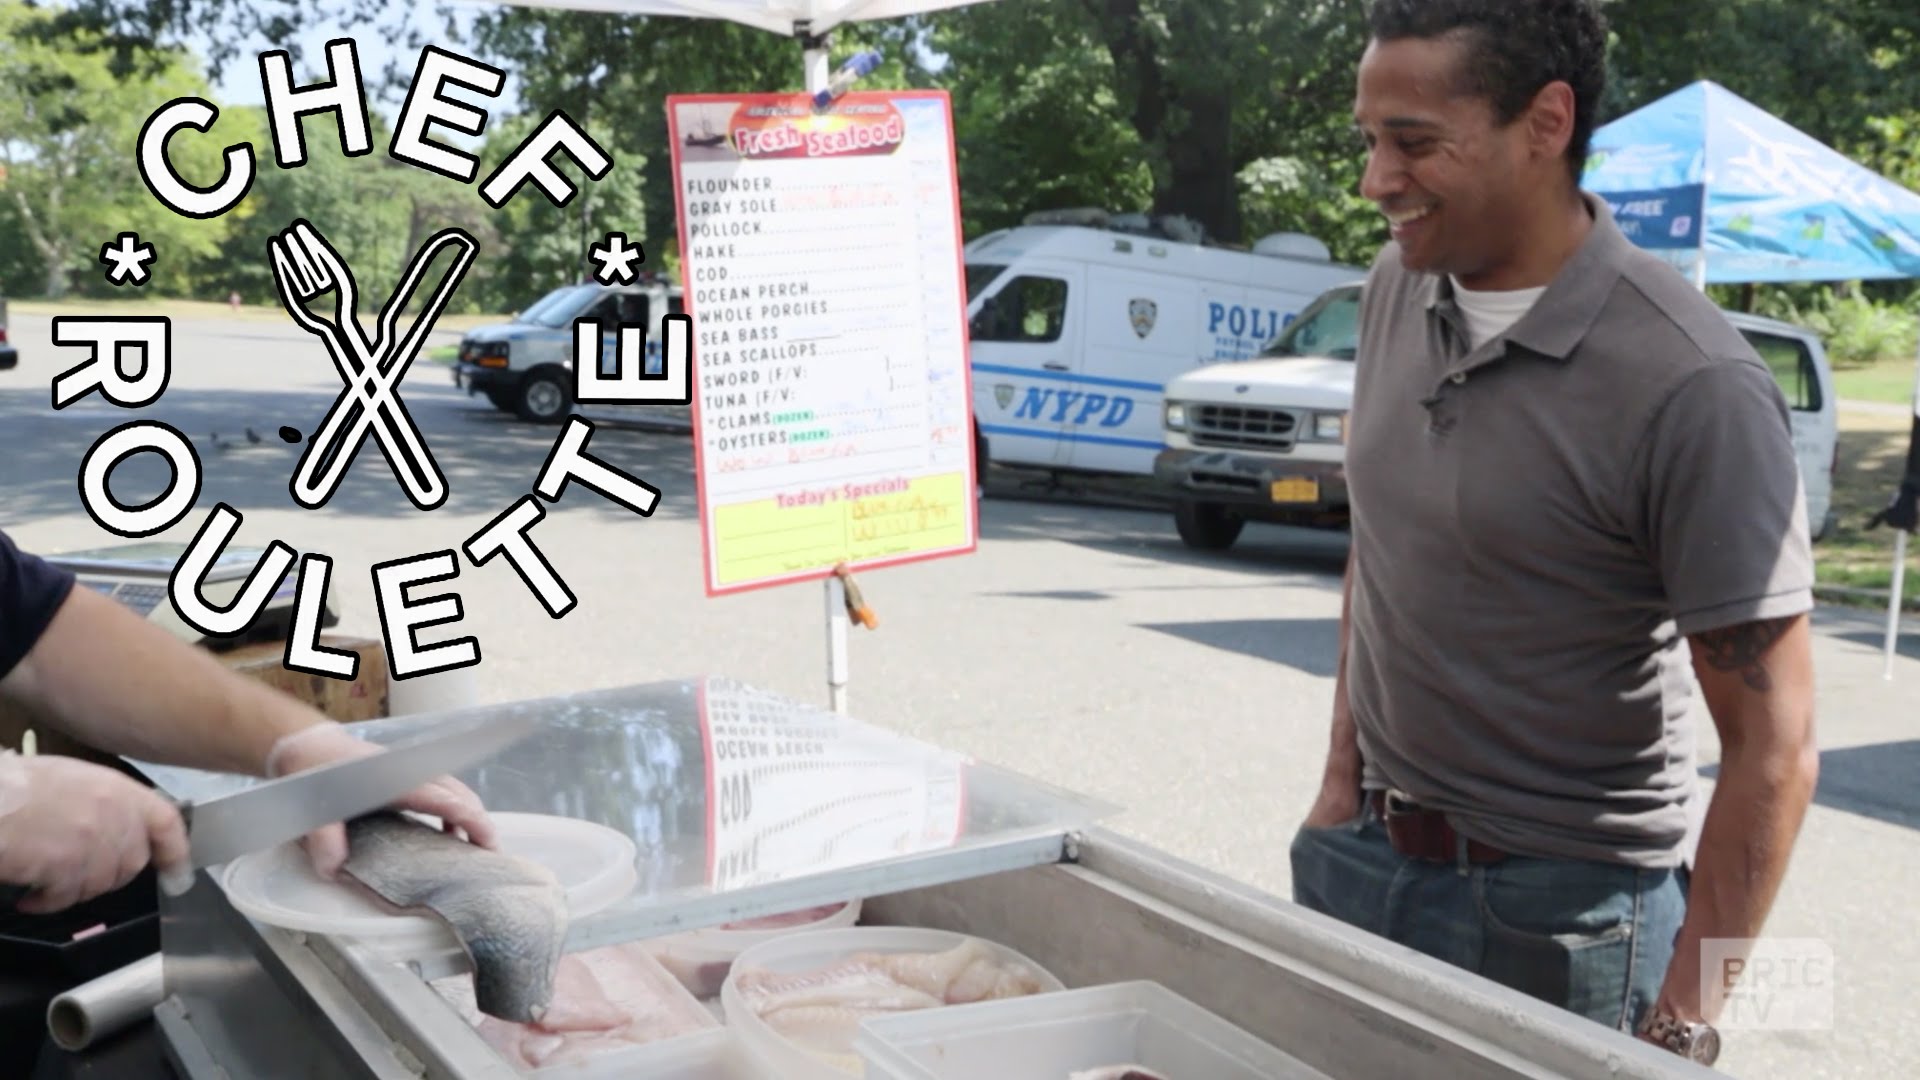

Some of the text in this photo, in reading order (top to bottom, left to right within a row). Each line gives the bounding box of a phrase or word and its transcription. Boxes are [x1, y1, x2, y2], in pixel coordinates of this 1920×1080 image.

[735, 115, 901, 157] Fresh Seafood
[687, 177, 773, 195] FLOUNDER
[689, 199, 778, 218] GRAY SOLE
[690, 222, 763, 239] POLLOCK
[693, 244, 736, 260] HAKE
[696, 267, 728, 282] COD
[697, 282, 811, 304] OCEAN PERCH
[699, 301, 829, 324] WHOLE PORGIES
[700, 326, 779, 346] SEA BASS
[702, 342, 818, 368] SEA SCALLOPS
[703, 370, 760, 389] SWORD
[704, 393, 747, 410] TUNA
[1014, 387, 1135, 428] NYPD
[776, 476, 911, 509] Today's Specials
